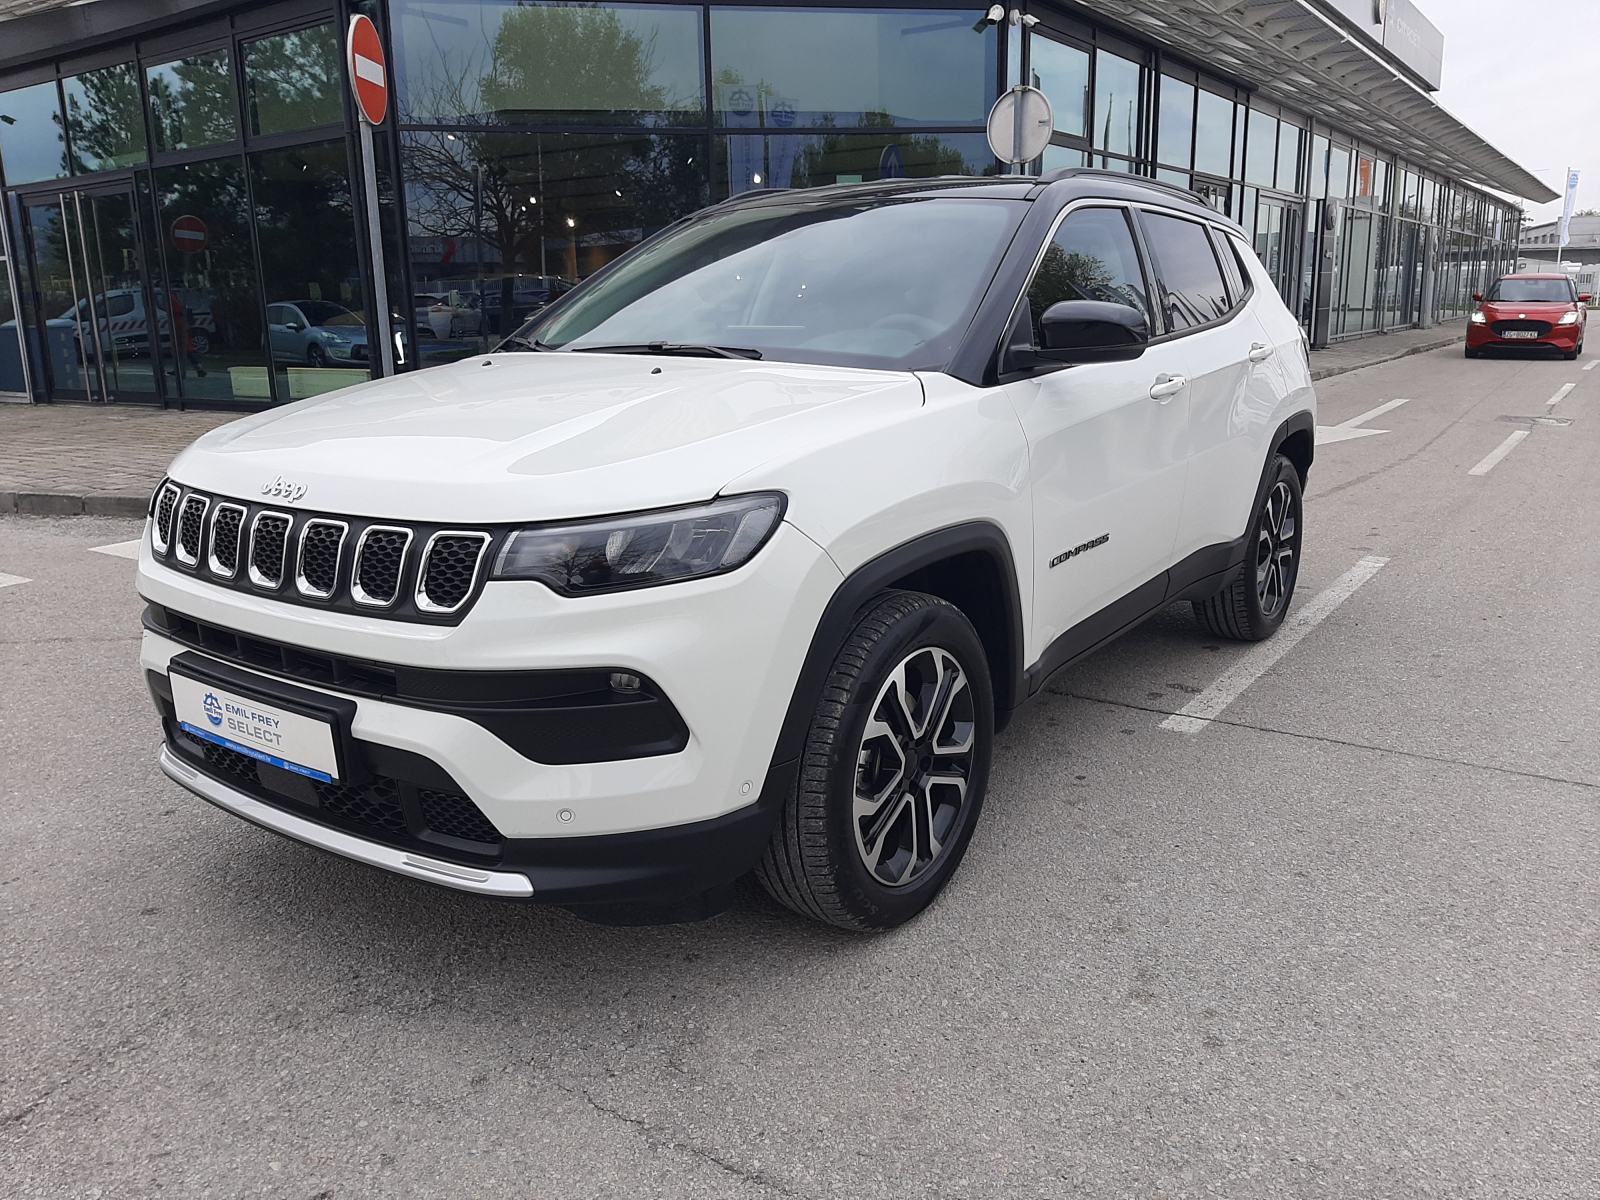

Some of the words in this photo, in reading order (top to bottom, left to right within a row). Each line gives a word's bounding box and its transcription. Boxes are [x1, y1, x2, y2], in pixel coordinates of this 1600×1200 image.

[261, 474, 308, 503] Jeep
[1049, 533, 1110, 569] COMPASS
[225, 703, 250, 719] EMIL
[251, 712, 280, 728] FREY
[227, 717, 282, 746] SELECT
